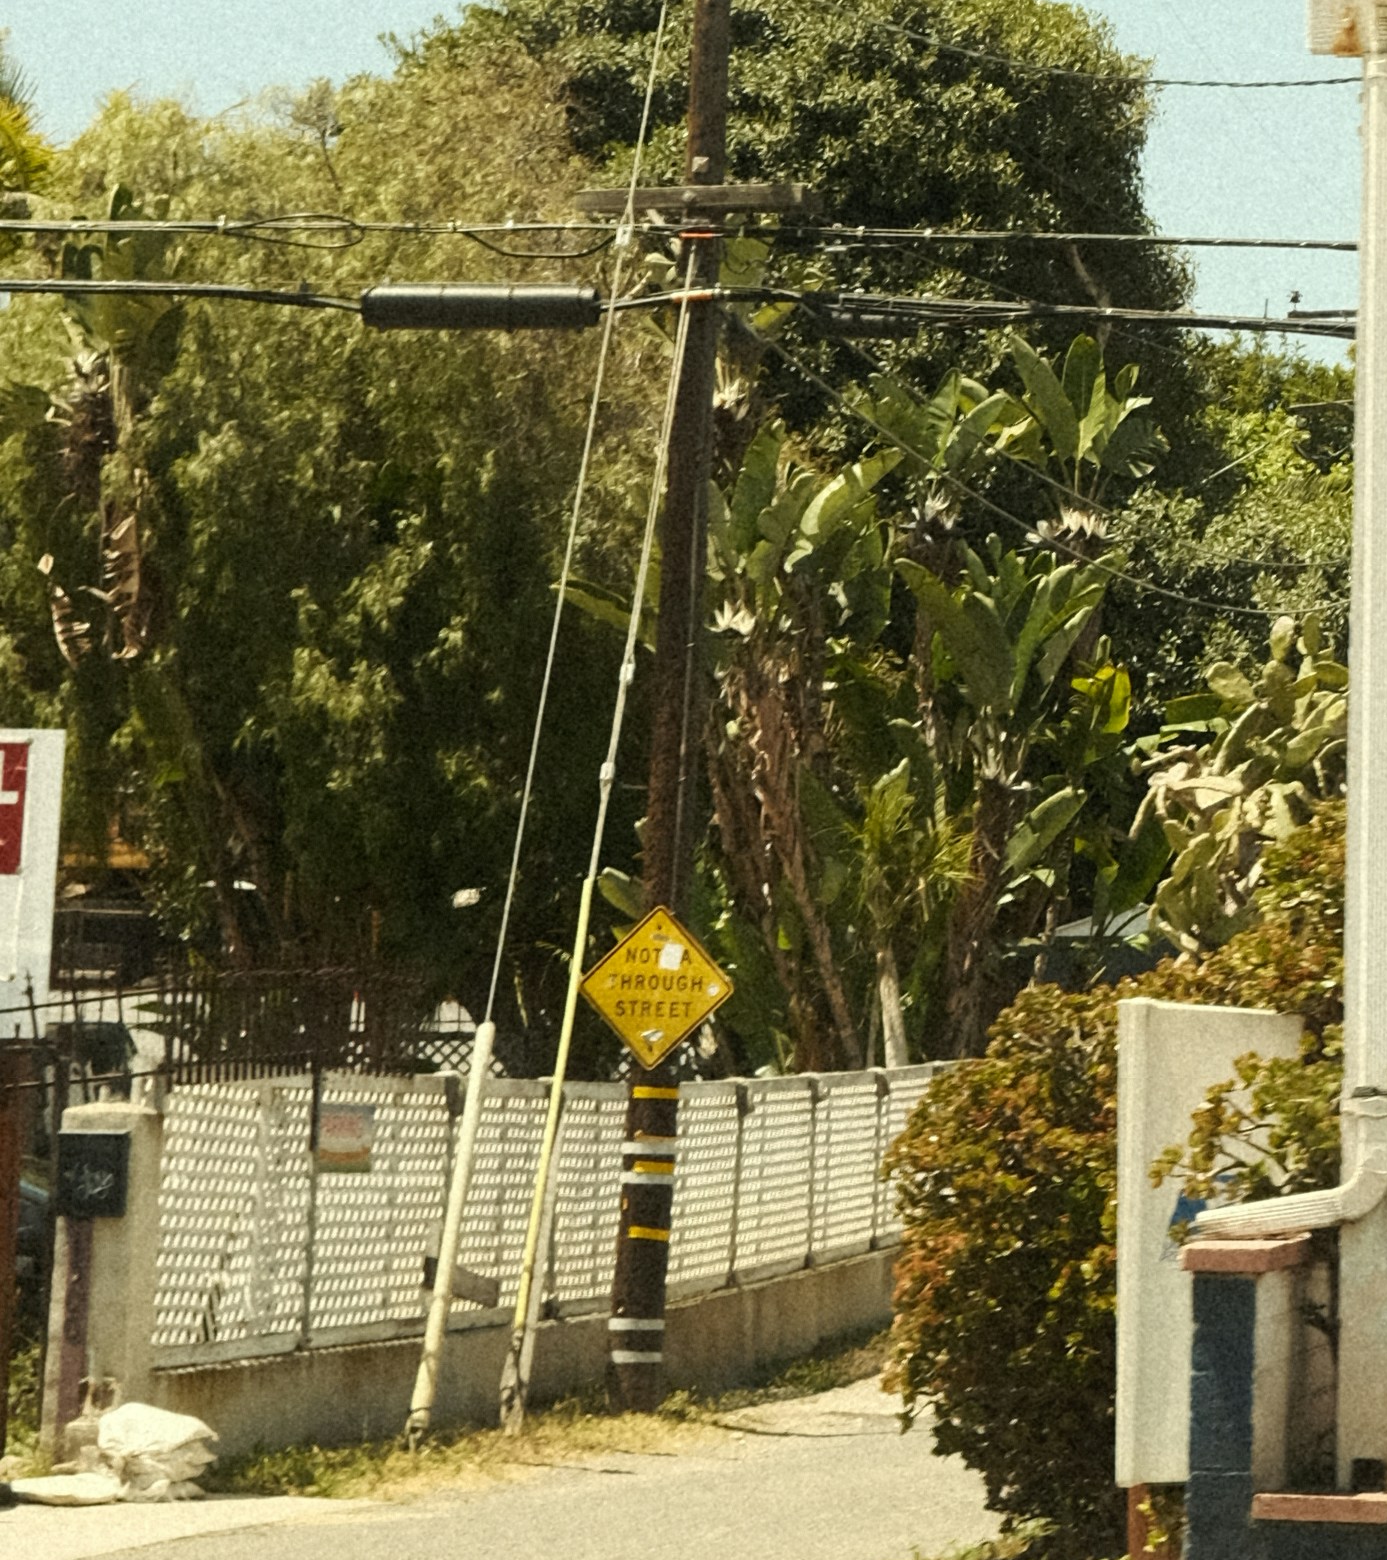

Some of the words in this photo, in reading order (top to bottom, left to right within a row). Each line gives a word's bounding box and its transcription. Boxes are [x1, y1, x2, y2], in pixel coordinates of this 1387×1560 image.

[625, 947, 660, 964] NOT
[681, 948, 692, 964] A
[609, 974, 703, 991] THROUGH
[615, 1000, 694, 1018] STREET
